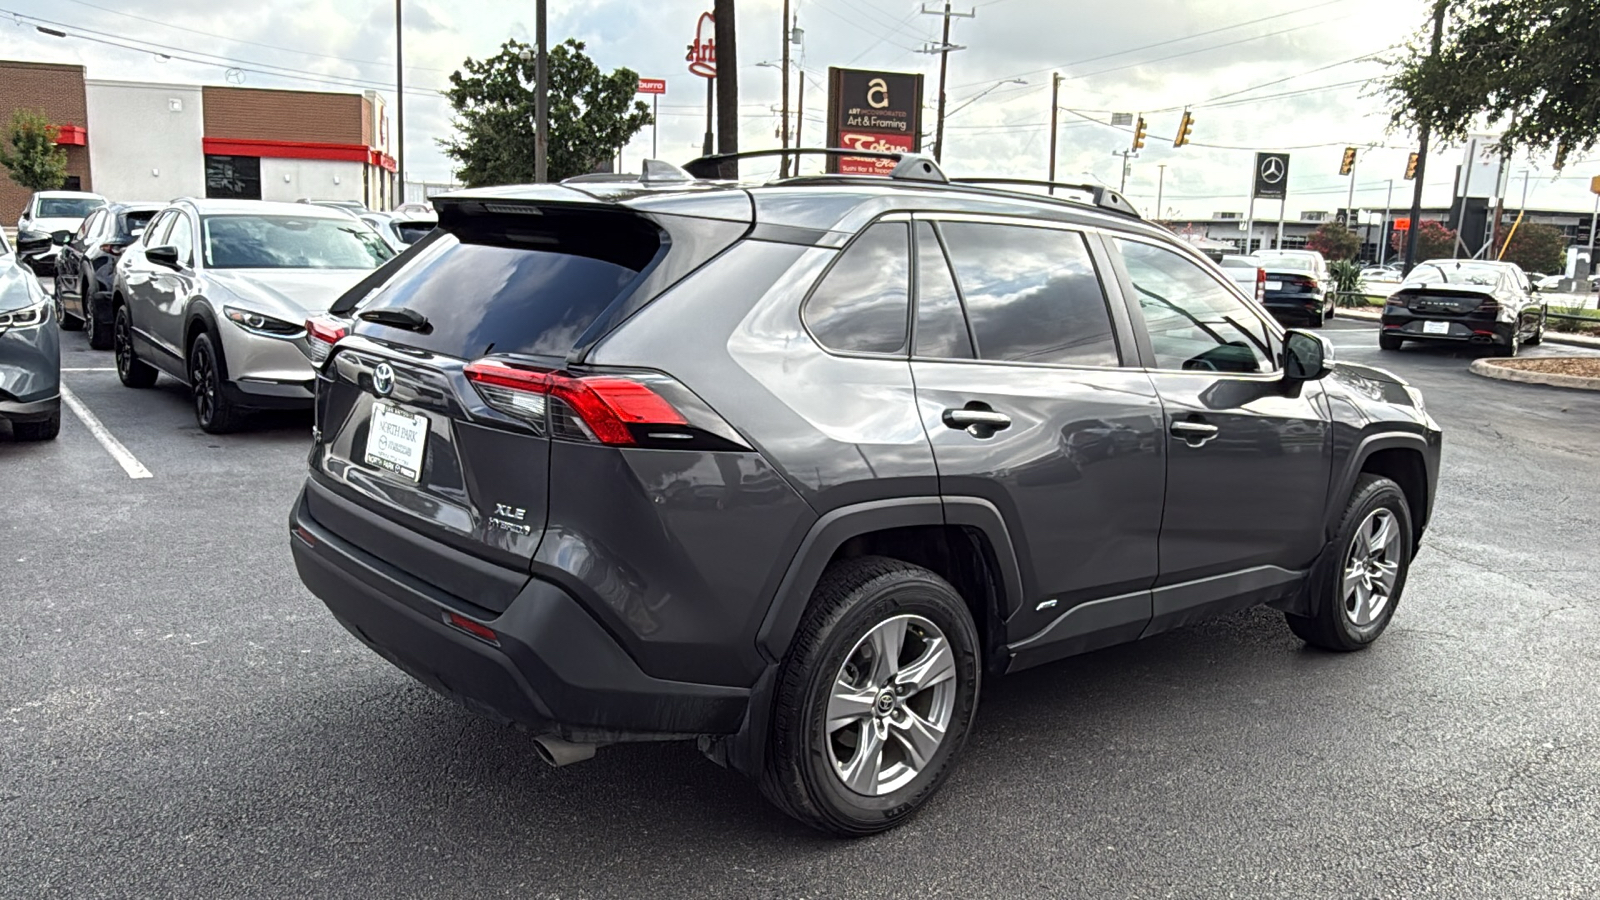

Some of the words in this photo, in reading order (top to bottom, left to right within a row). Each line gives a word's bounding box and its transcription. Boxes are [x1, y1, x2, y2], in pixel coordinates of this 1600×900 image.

[860, 109, 907, 117] INCORPORATED
[847, 116, 862, 126] Art
[862, 116, 870, 126] &
[871, 116, 907, 131] Framing
[379, 420, 400, 438] NORTH
[400, 427, 418, 443] PARK
[494, 502, 526, 520] XLE
